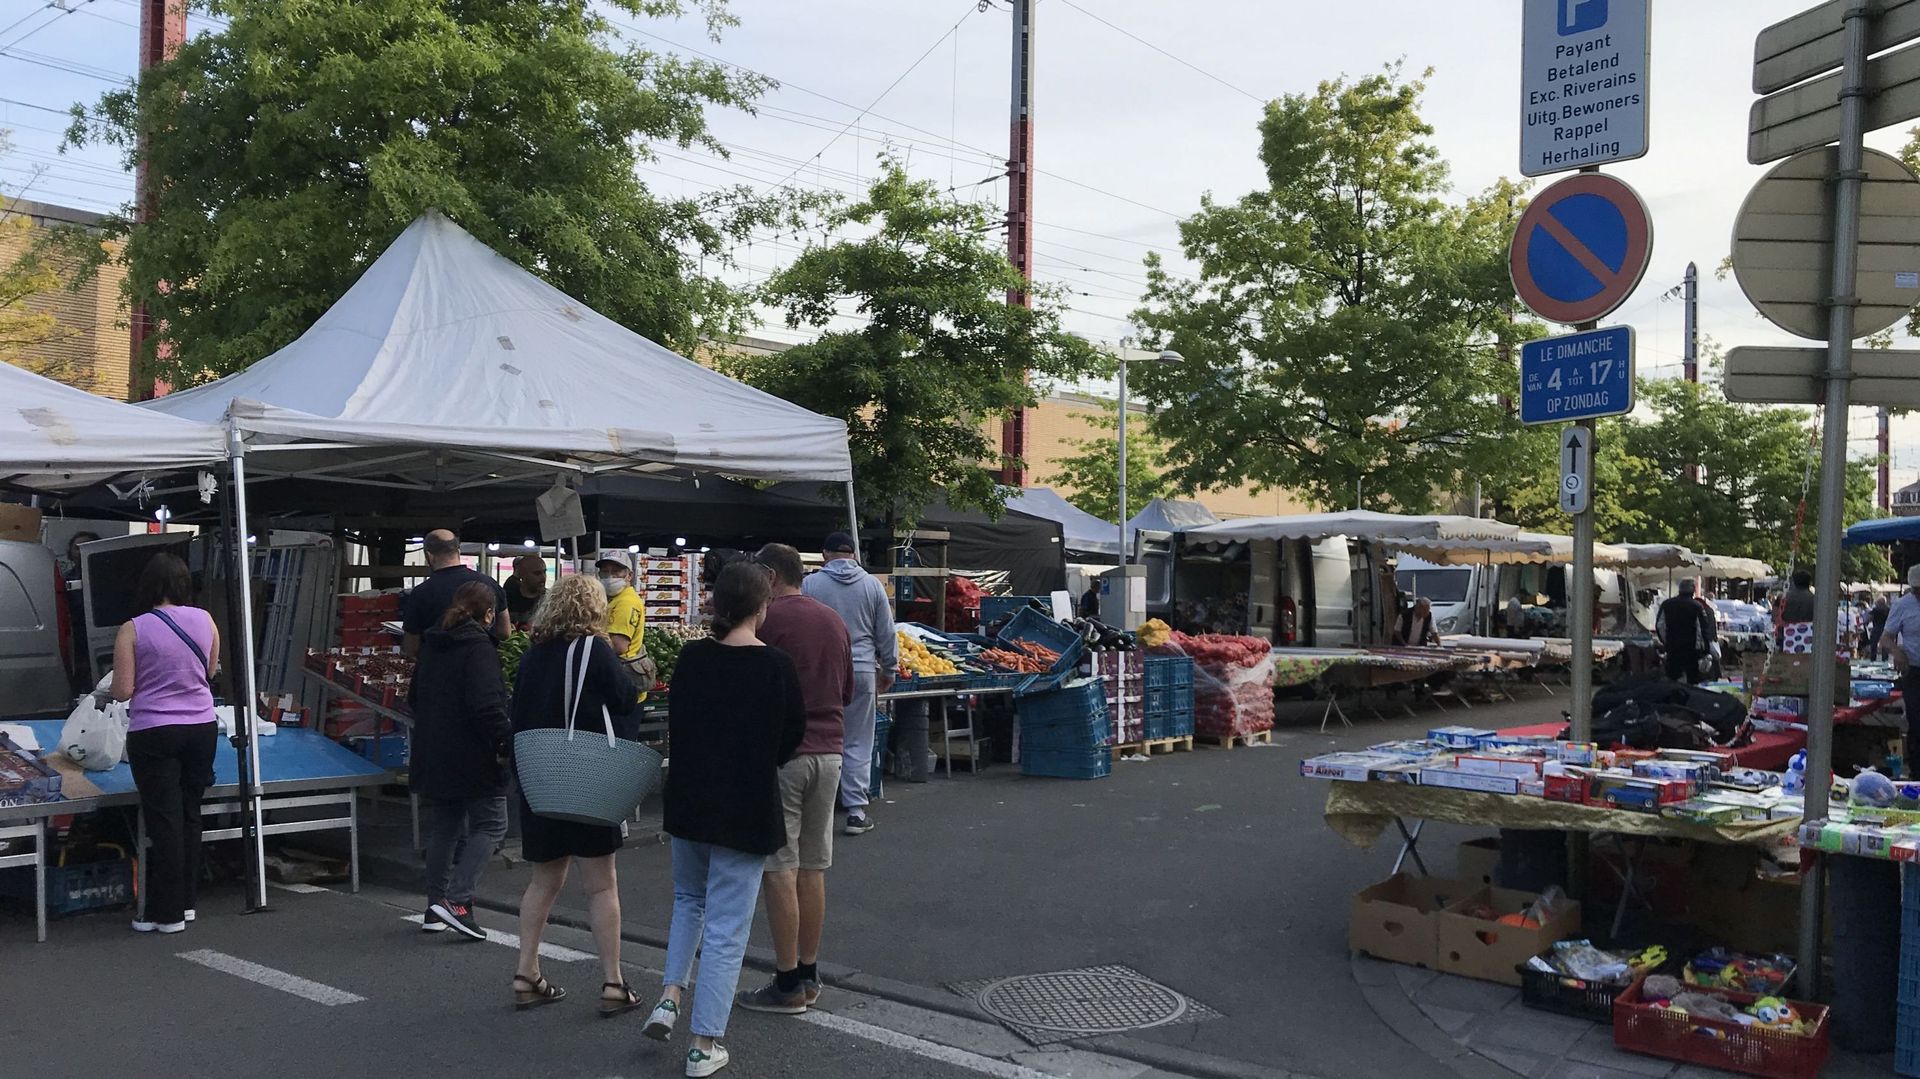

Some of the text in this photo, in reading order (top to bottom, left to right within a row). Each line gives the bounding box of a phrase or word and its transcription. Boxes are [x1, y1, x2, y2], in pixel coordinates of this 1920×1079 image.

[1556, 34, 1611, 59] Payant
[1547, 53, 1619, 82] Betalend
[1530, 72, 1637, 105] Exc. Riverains
[1527, 94, 1640, 127] Uitg. Bewoners
[1554, 118, 1609, 141] Rappel
[1542, 141, 1620, 165] Herhaling
[1541, 336, 1613, 362] LE DIMANCHE
[1590, 359, 1613, 386] 17
[1618, 360, 1625, 368] H
[1618, 370, 1625, 379] U
[1527, 383, 1542, 392] VAN
[1528, 373, 1539, 382] DE
[1547, 368, 1562, 391] 4
[1568, 376, 1583, 386] TOT
[1547, 391, 1609, 413] OP ZONDAG
